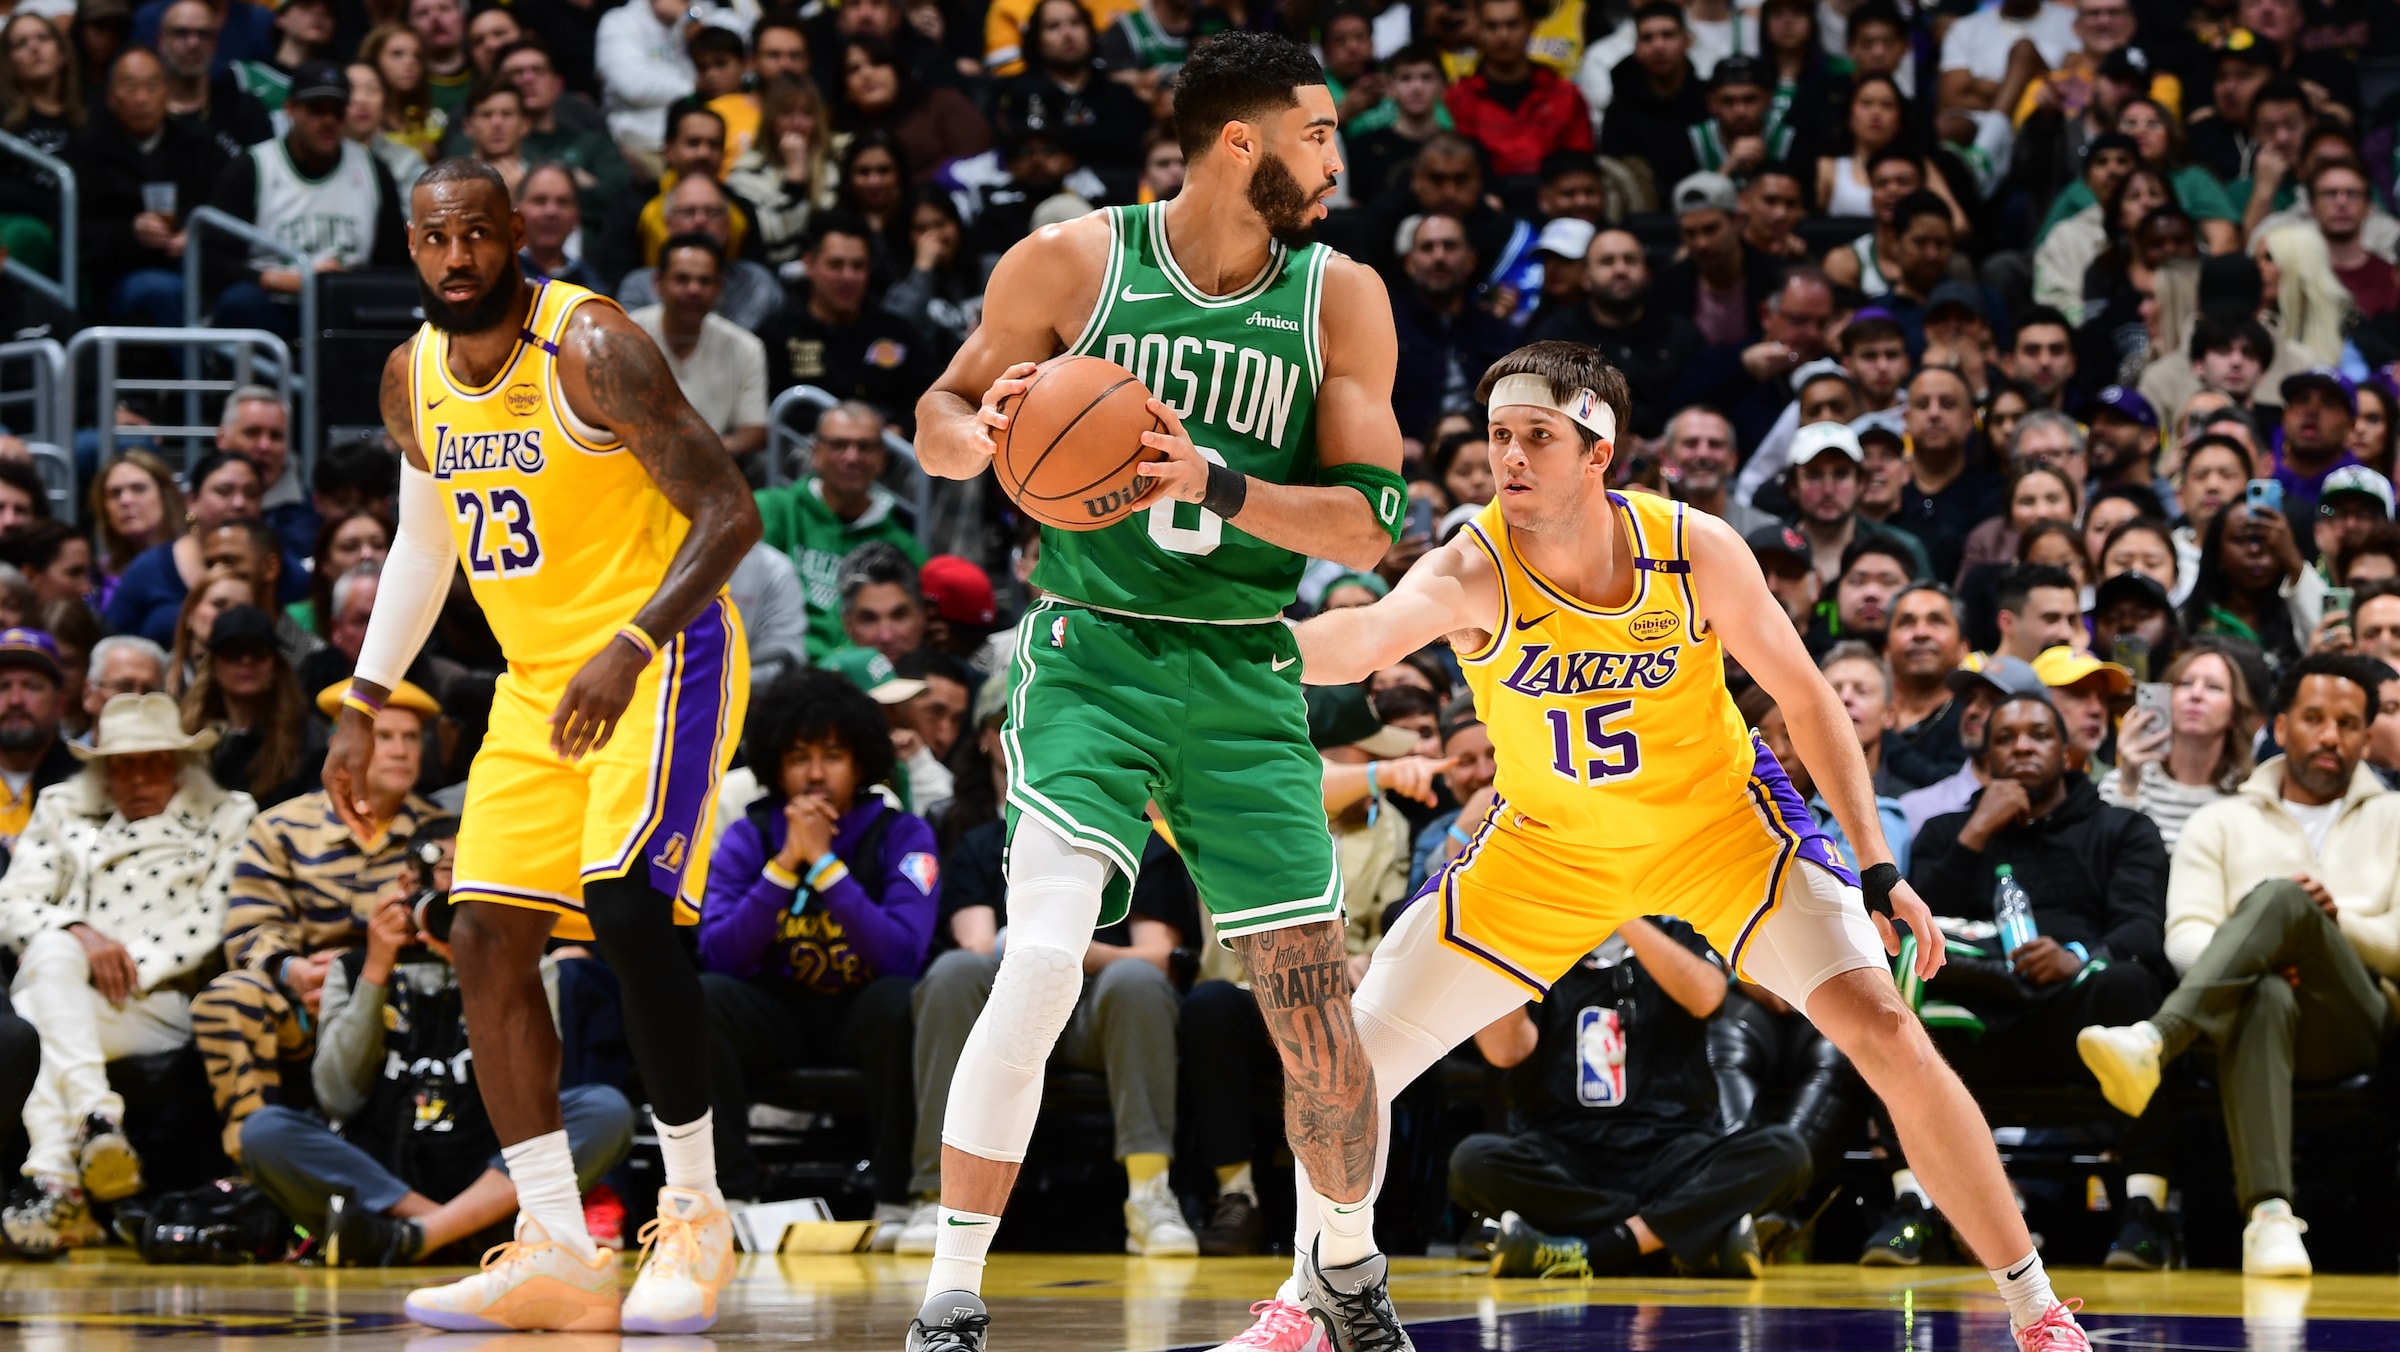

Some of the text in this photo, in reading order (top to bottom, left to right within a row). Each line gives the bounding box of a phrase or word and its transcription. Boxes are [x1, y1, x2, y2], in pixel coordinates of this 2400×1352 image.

[1246, 311, 1299, 332] Amica
[433, 425, 546, 480] LAKERS
[1083, 475, 1153, 518] Wil
[1380, 486, 1401, 525] 0
[453, 488, 543, 578] 23
[1653, 561, 1667, 572] 44
[1633, 618, 1677, 631] bibigo
[1500, 645, 1680, 698] LAKERS
[1545, 699, 1641, 786] 15
[1260, 961, 1349, 1010] GRATEFU
